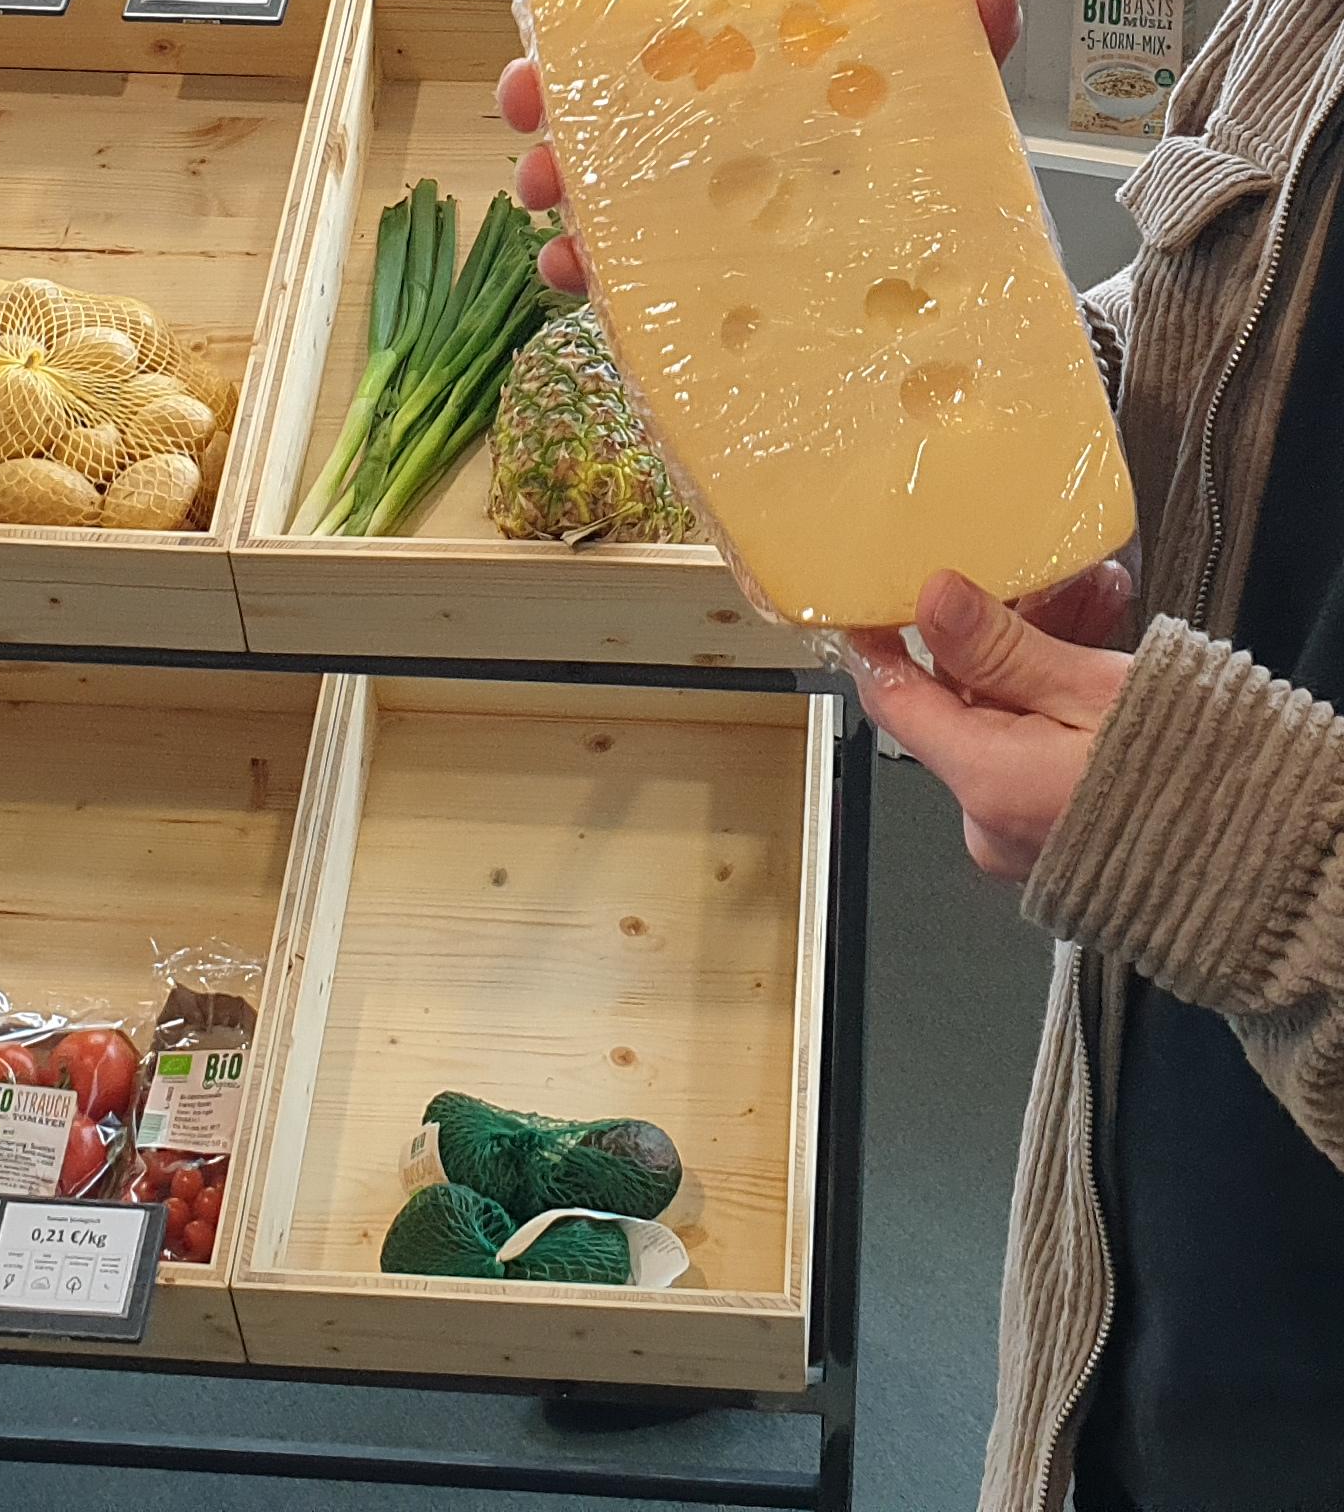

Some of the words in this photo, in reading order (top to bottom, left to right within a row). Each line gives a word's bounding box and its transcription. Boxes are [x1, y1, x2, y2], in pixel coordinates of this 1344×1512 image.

[14, 1090, 72, 1119] STRAUCH
[31, 1227, 65, 1244] 0,21
[70, 1228, 108, 1249] €/kg
